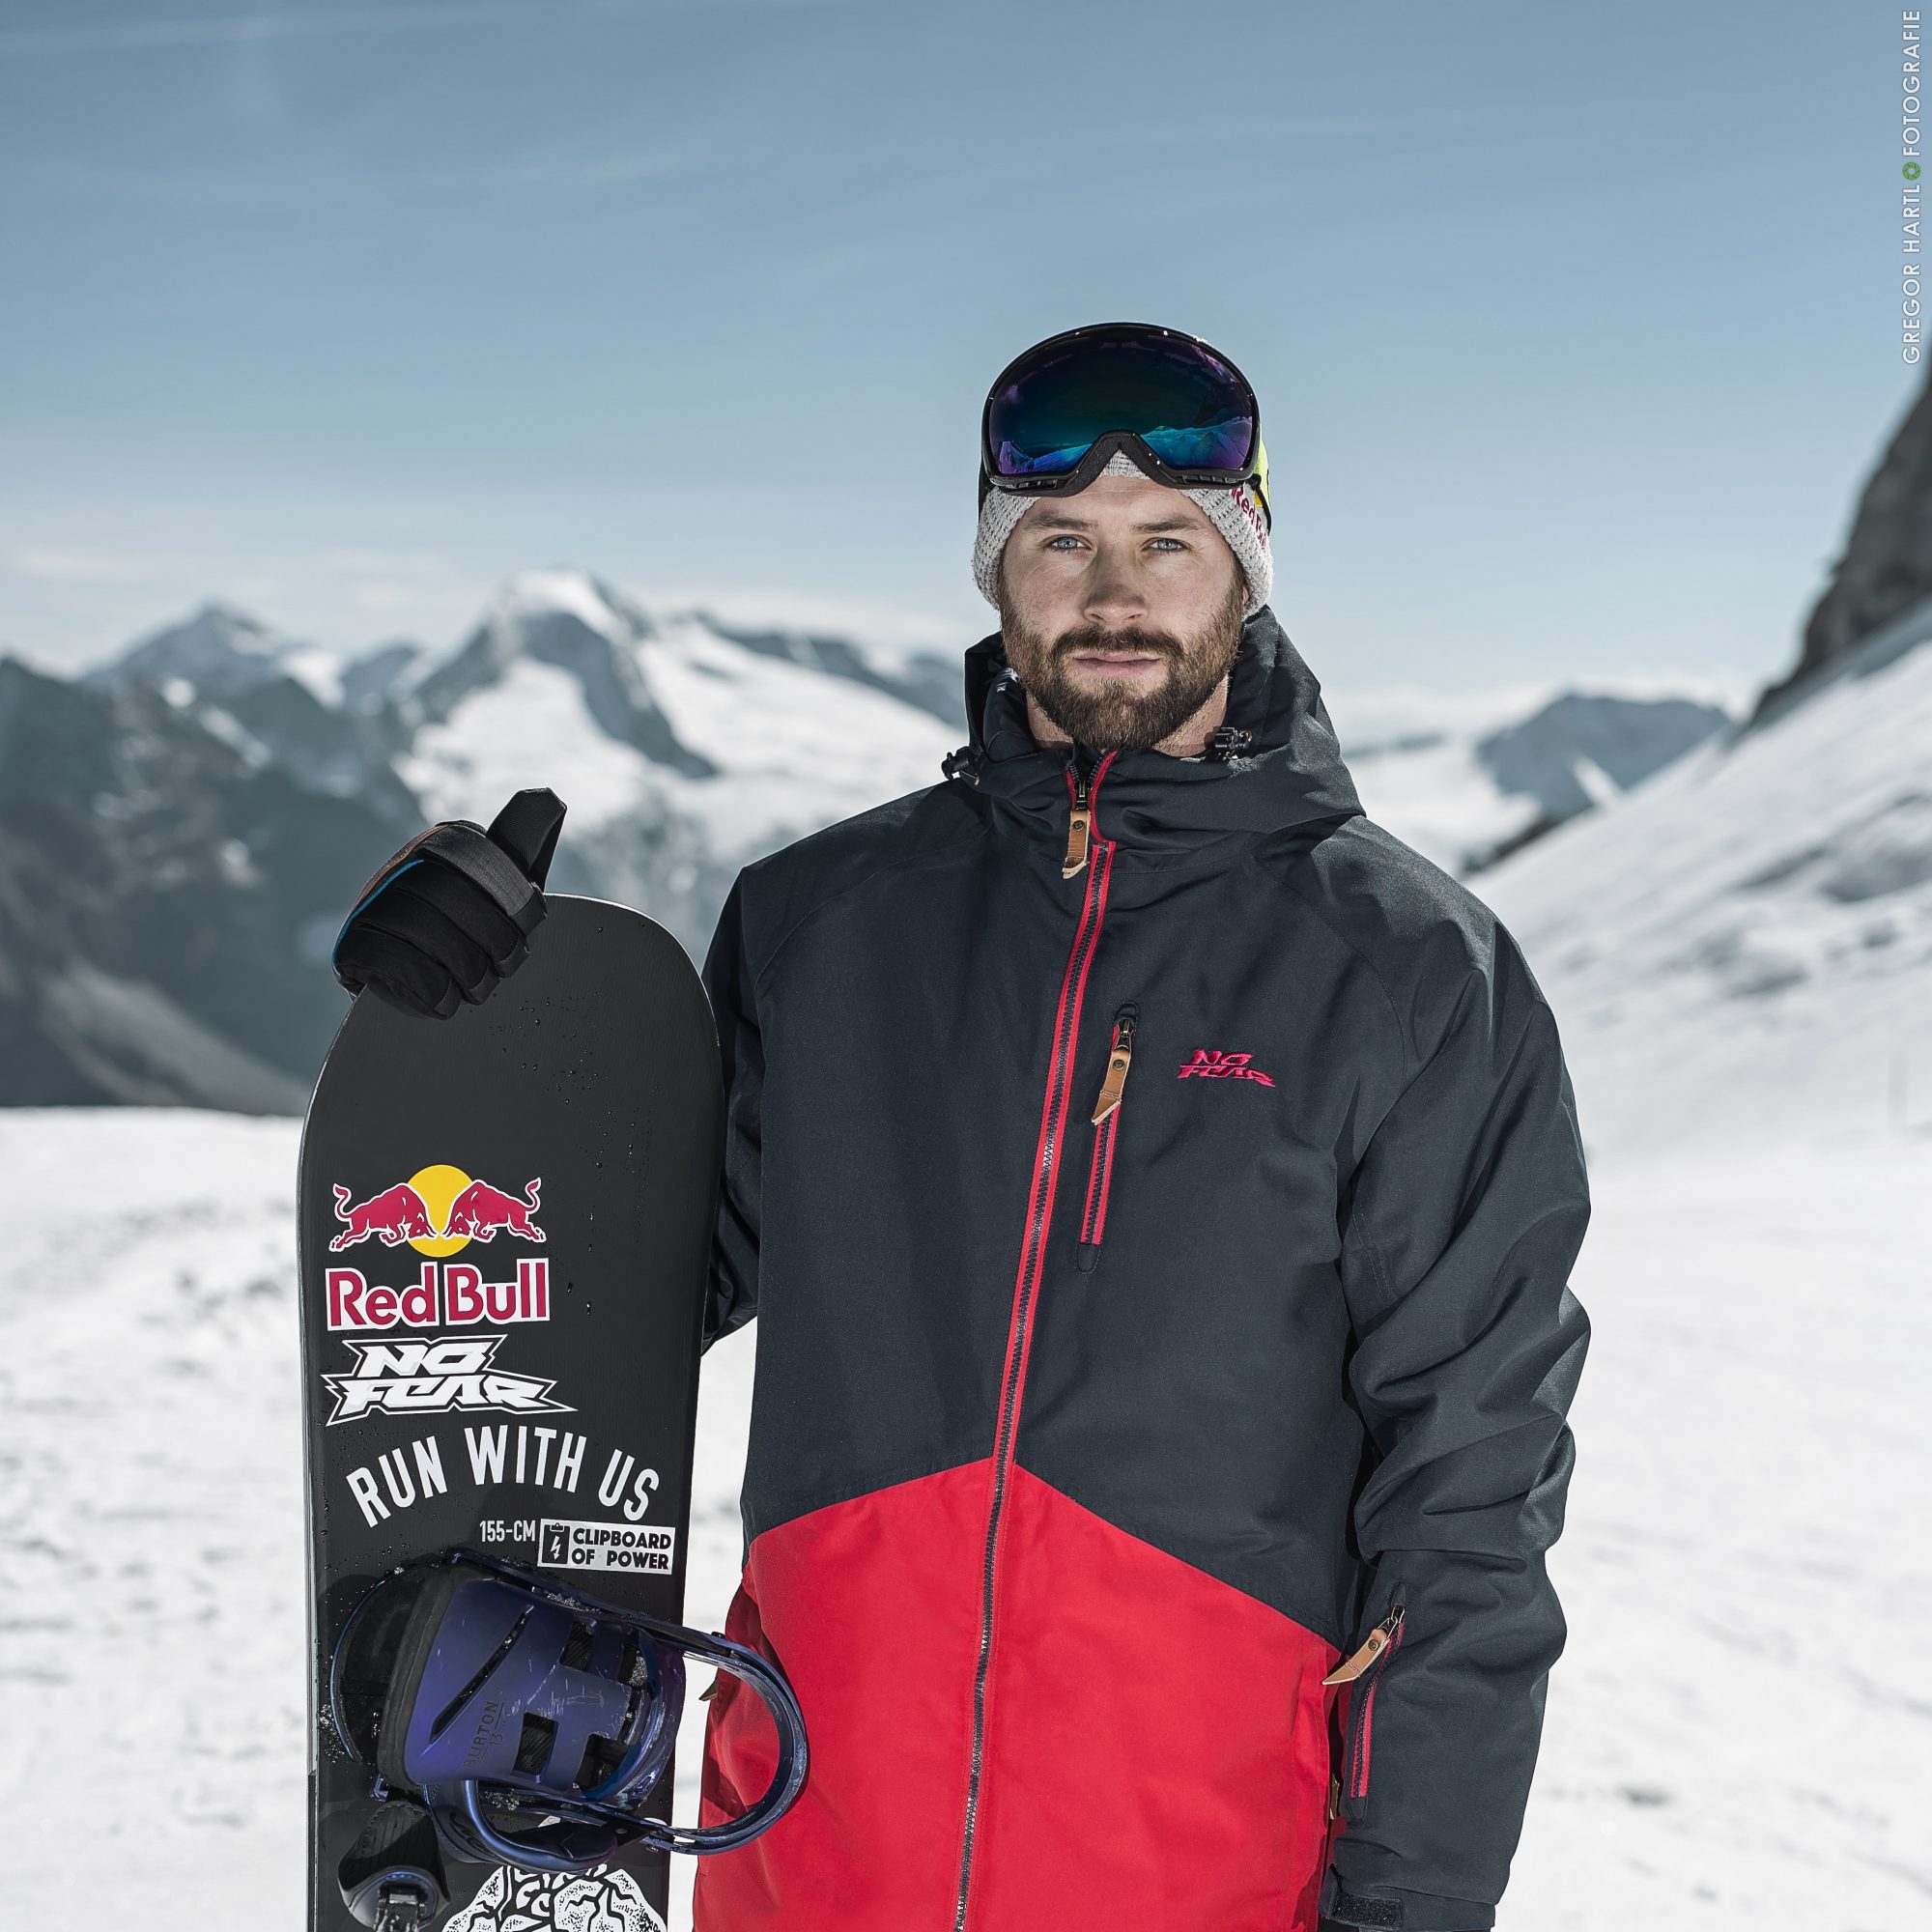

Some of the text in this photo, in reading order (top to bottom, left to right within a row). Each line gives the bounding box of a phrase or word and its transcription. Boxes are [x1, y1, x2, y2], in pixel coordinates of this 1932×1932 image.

[1191, 1049, 1253, 1065] NO
[1178, 1065, 1276, 1088] FEAR
[327, 1259, 549, 1329] Red Bull
[356, 1341, 494, 1378] NO
[337, 1374, 551, 1417] FEAR
[346, 1424, 660, 1528] RUN WITH US
[479, 1520, 536, 1543] 155-CM
[572, 1526, 672, 1550] CLIPBOARD
[571, 1548, 670, 1570] OF POWER
[463, 1701, 499, 1769] BURTON
